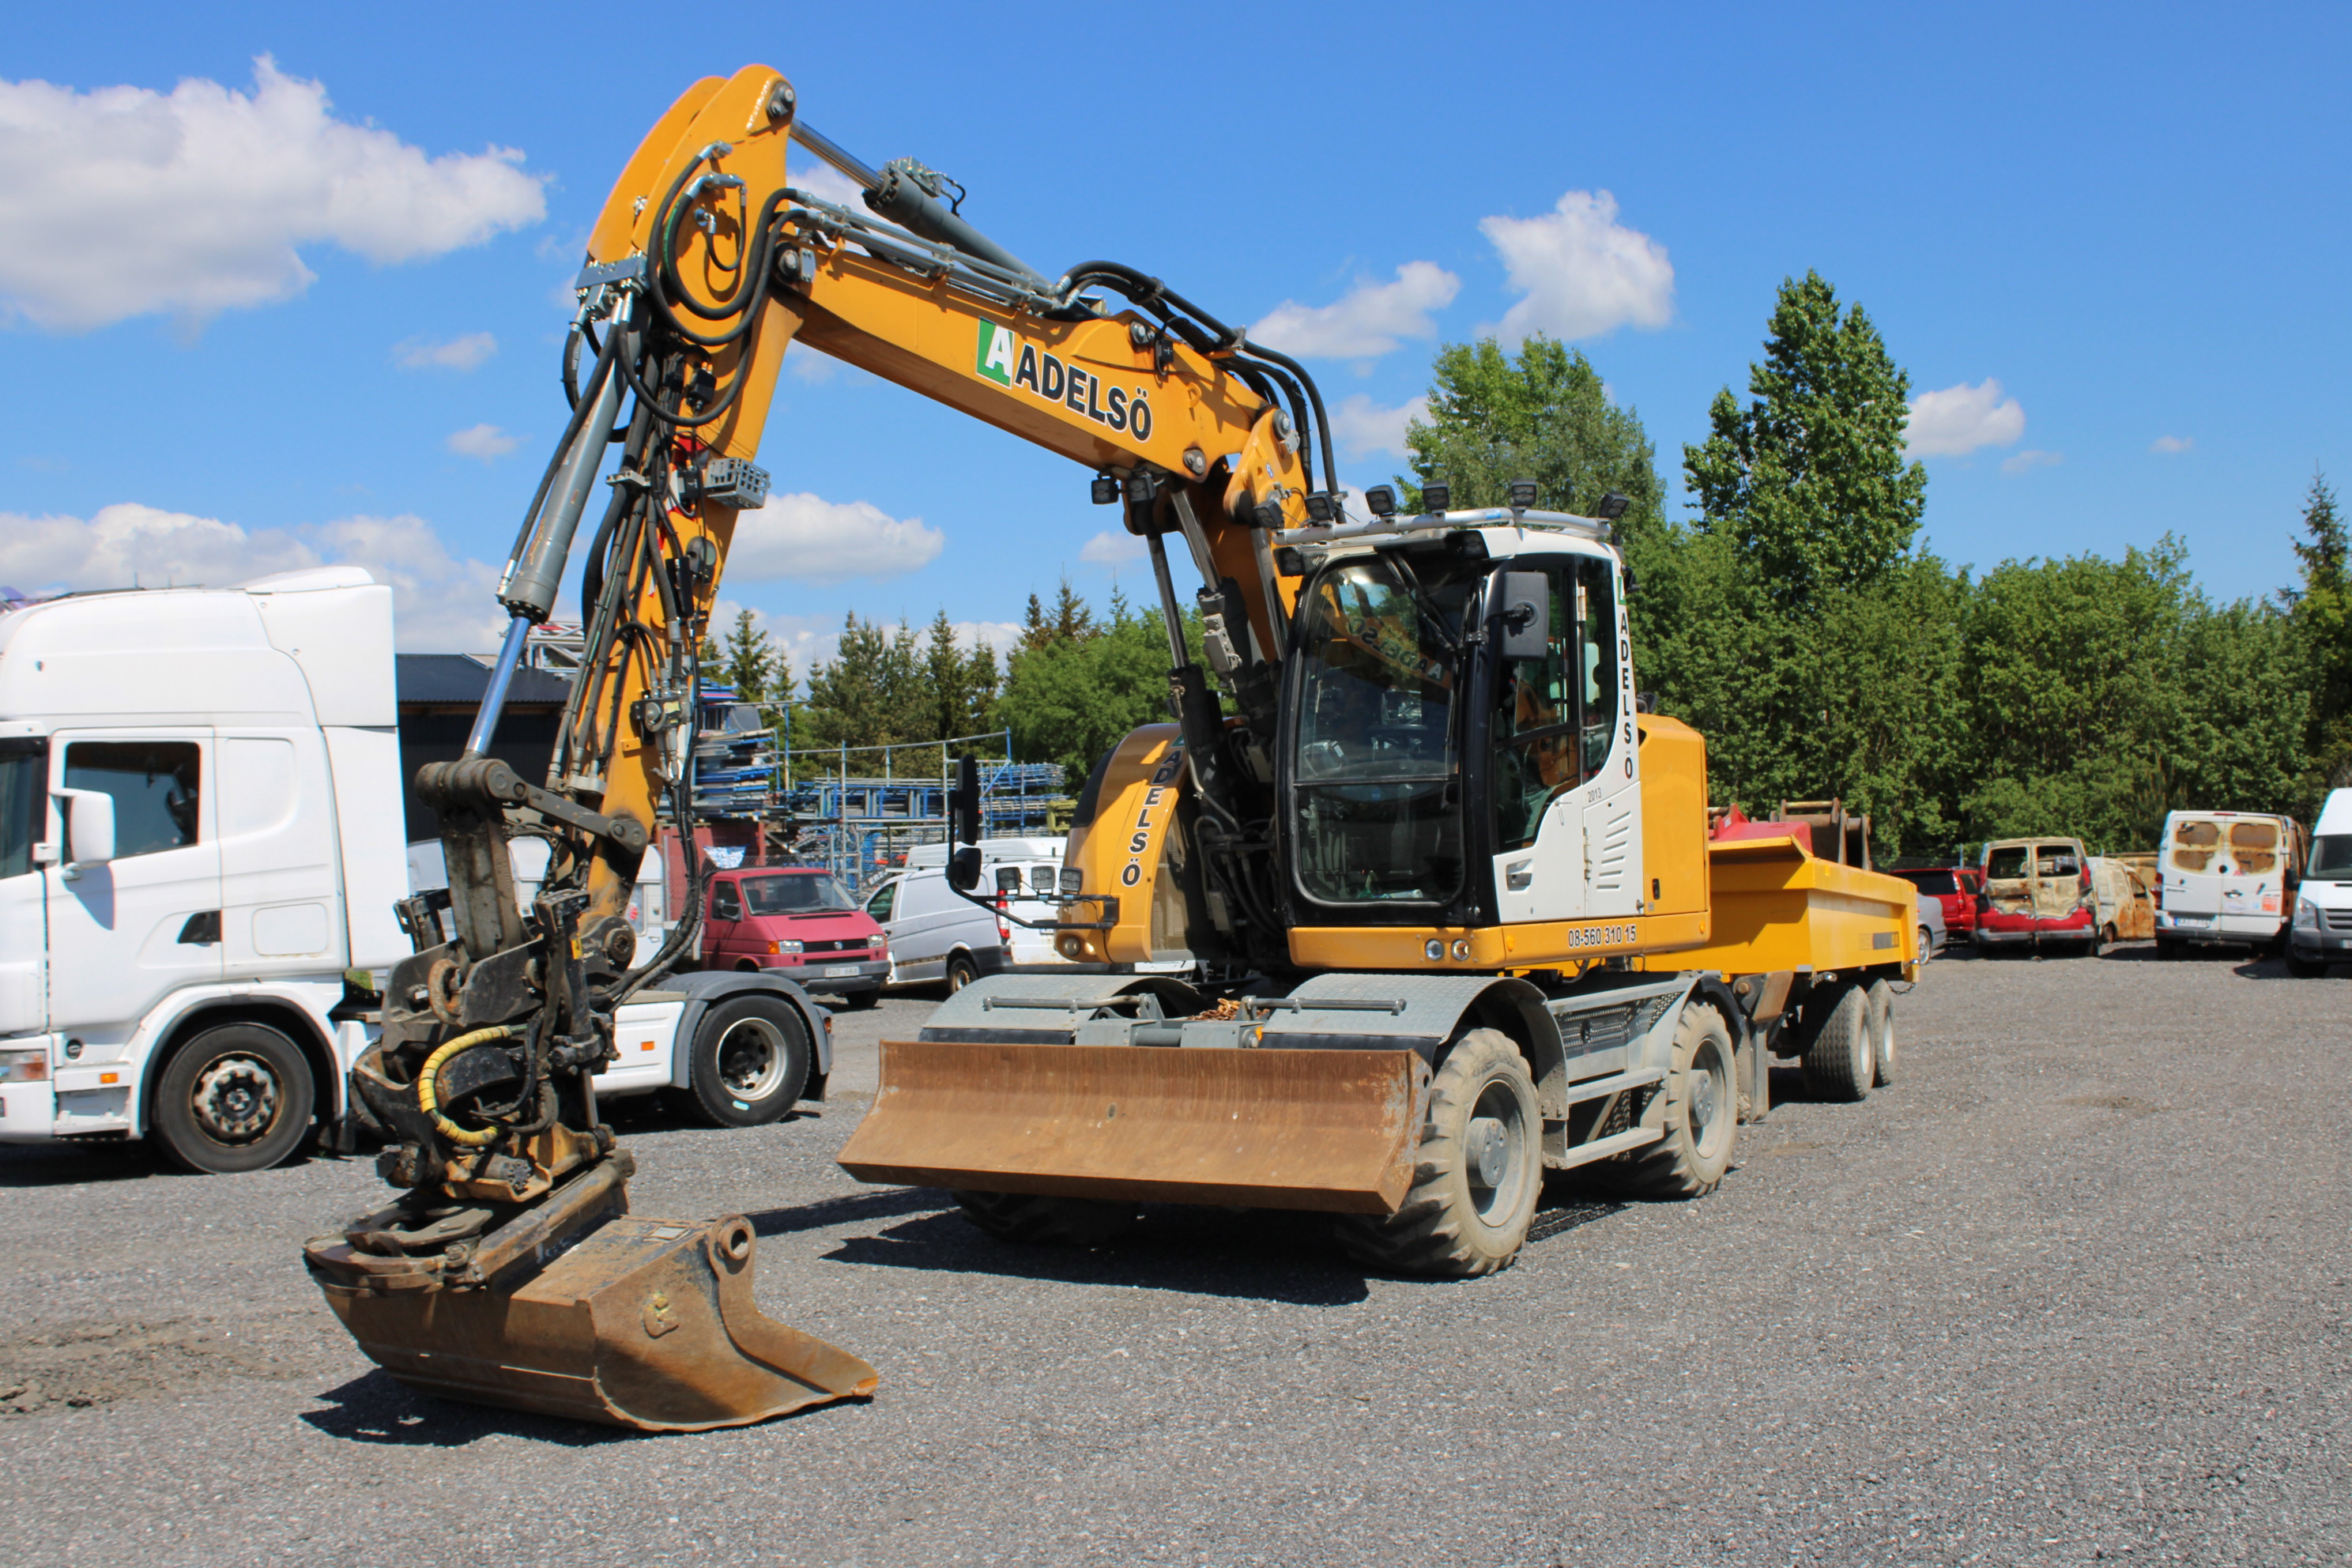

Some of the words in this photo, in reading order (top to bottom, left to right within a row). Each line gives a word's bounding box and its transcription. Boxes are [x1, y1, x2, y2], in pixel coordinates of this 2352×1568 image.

[1015, 345, 1152, 443] ADELSÖ
[1620, 612, 1634, 779] ADELSÖ
[1121, 750, 1183, 887] ADELSÖ
[1587, 787, 1603, 803] 2013
[1568, 928, 1602, 948] 08-560
[1604, 925, 1622, 945] 310
[1625, 924, 1637, 944] 15
